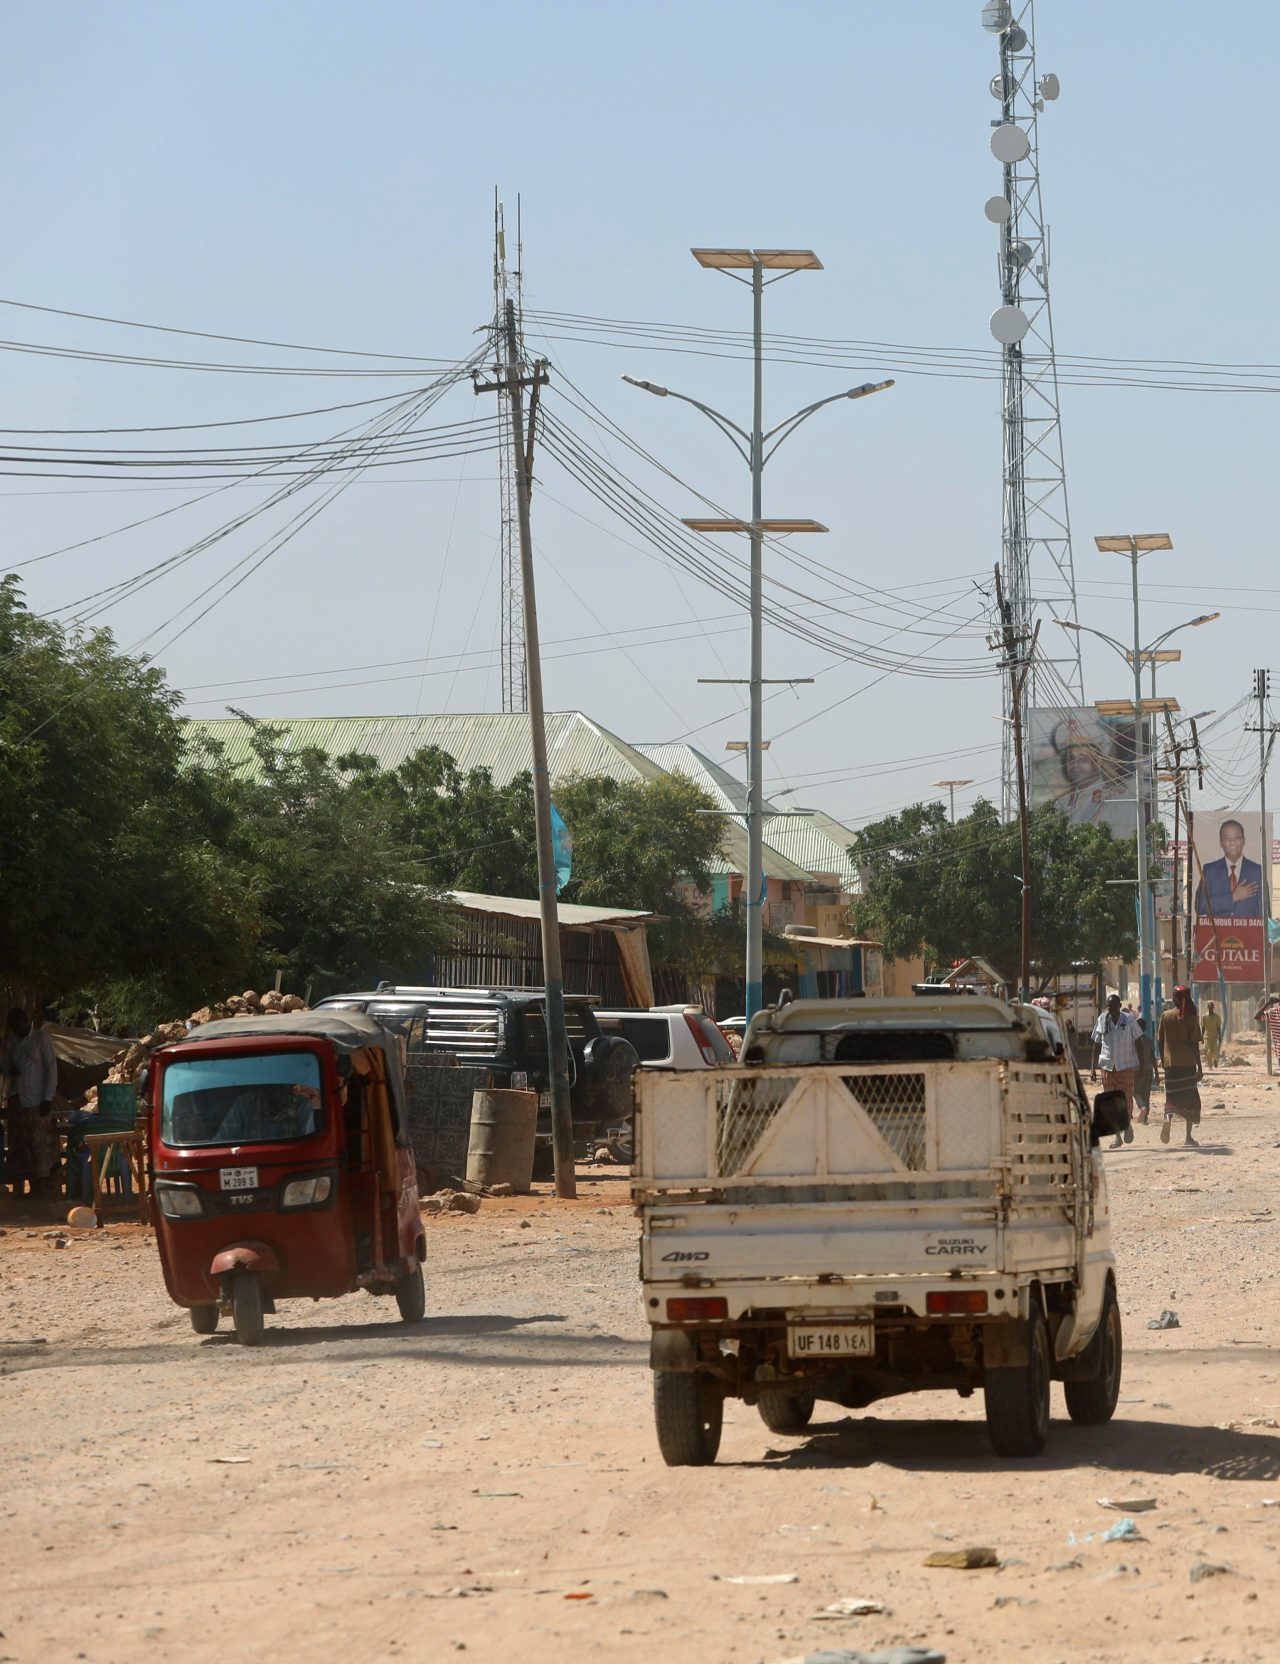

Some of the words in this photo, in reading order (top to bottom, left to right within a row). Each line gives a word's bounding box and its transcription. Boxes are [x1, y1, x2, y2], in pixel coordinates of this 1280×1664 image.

[1234, 918, 1248, 926] ISKU
[224, 1179, 230, 1187] M
[232, 1178, 246, 1187] 299
[249, 1177, 254, 1186] S
[230, 1195, 253, 1204] TVS
[925, 1245, 987, 1256] CARRY
[661, 1251, 710, 1262] 4WD
[798, 1335, 814, 1350] UF
[818, 1335, 840, 1350] 148
[844, 1334, 866, 1349] ١٤٨
